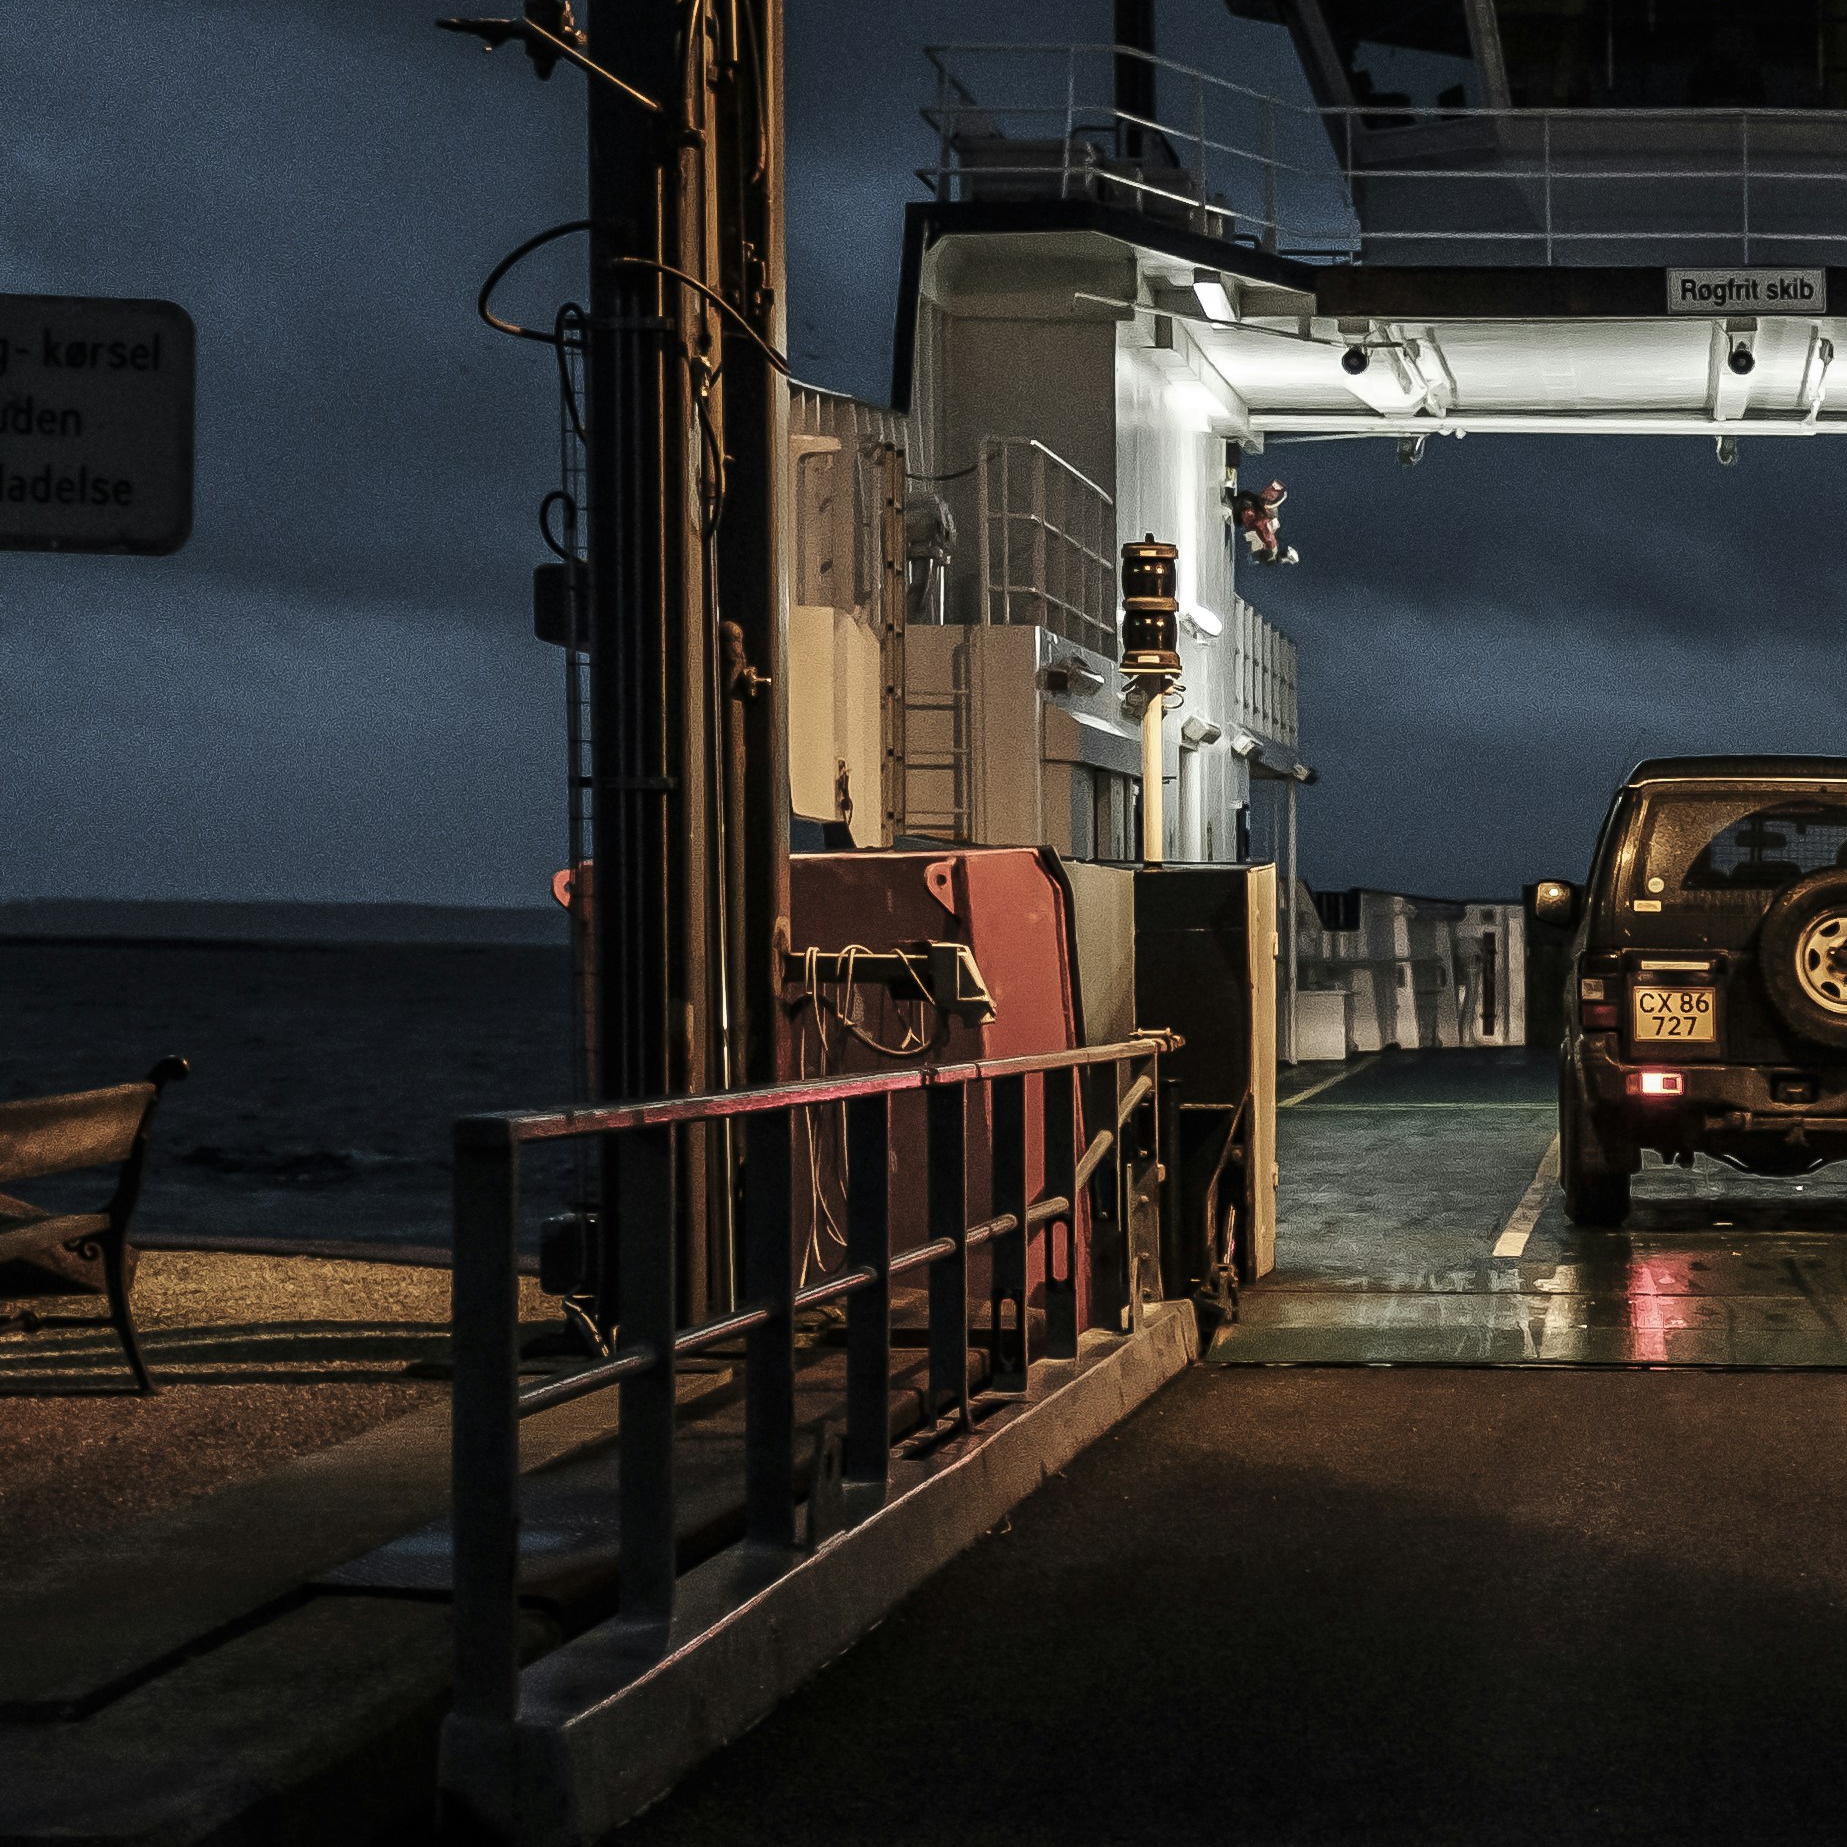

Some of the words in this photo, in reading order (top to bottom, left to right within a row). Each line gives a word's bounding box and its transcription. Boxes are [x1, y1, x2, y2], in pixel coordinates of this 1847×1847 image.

[1766, 277, 1814, 301] skib
[43, 327, 161, 372] kørsel
[1639, 993, 1672, 1014] CX
[1679, 992, 1710, 1013] 86
[1652, 1016, 1698, 1037] 727
